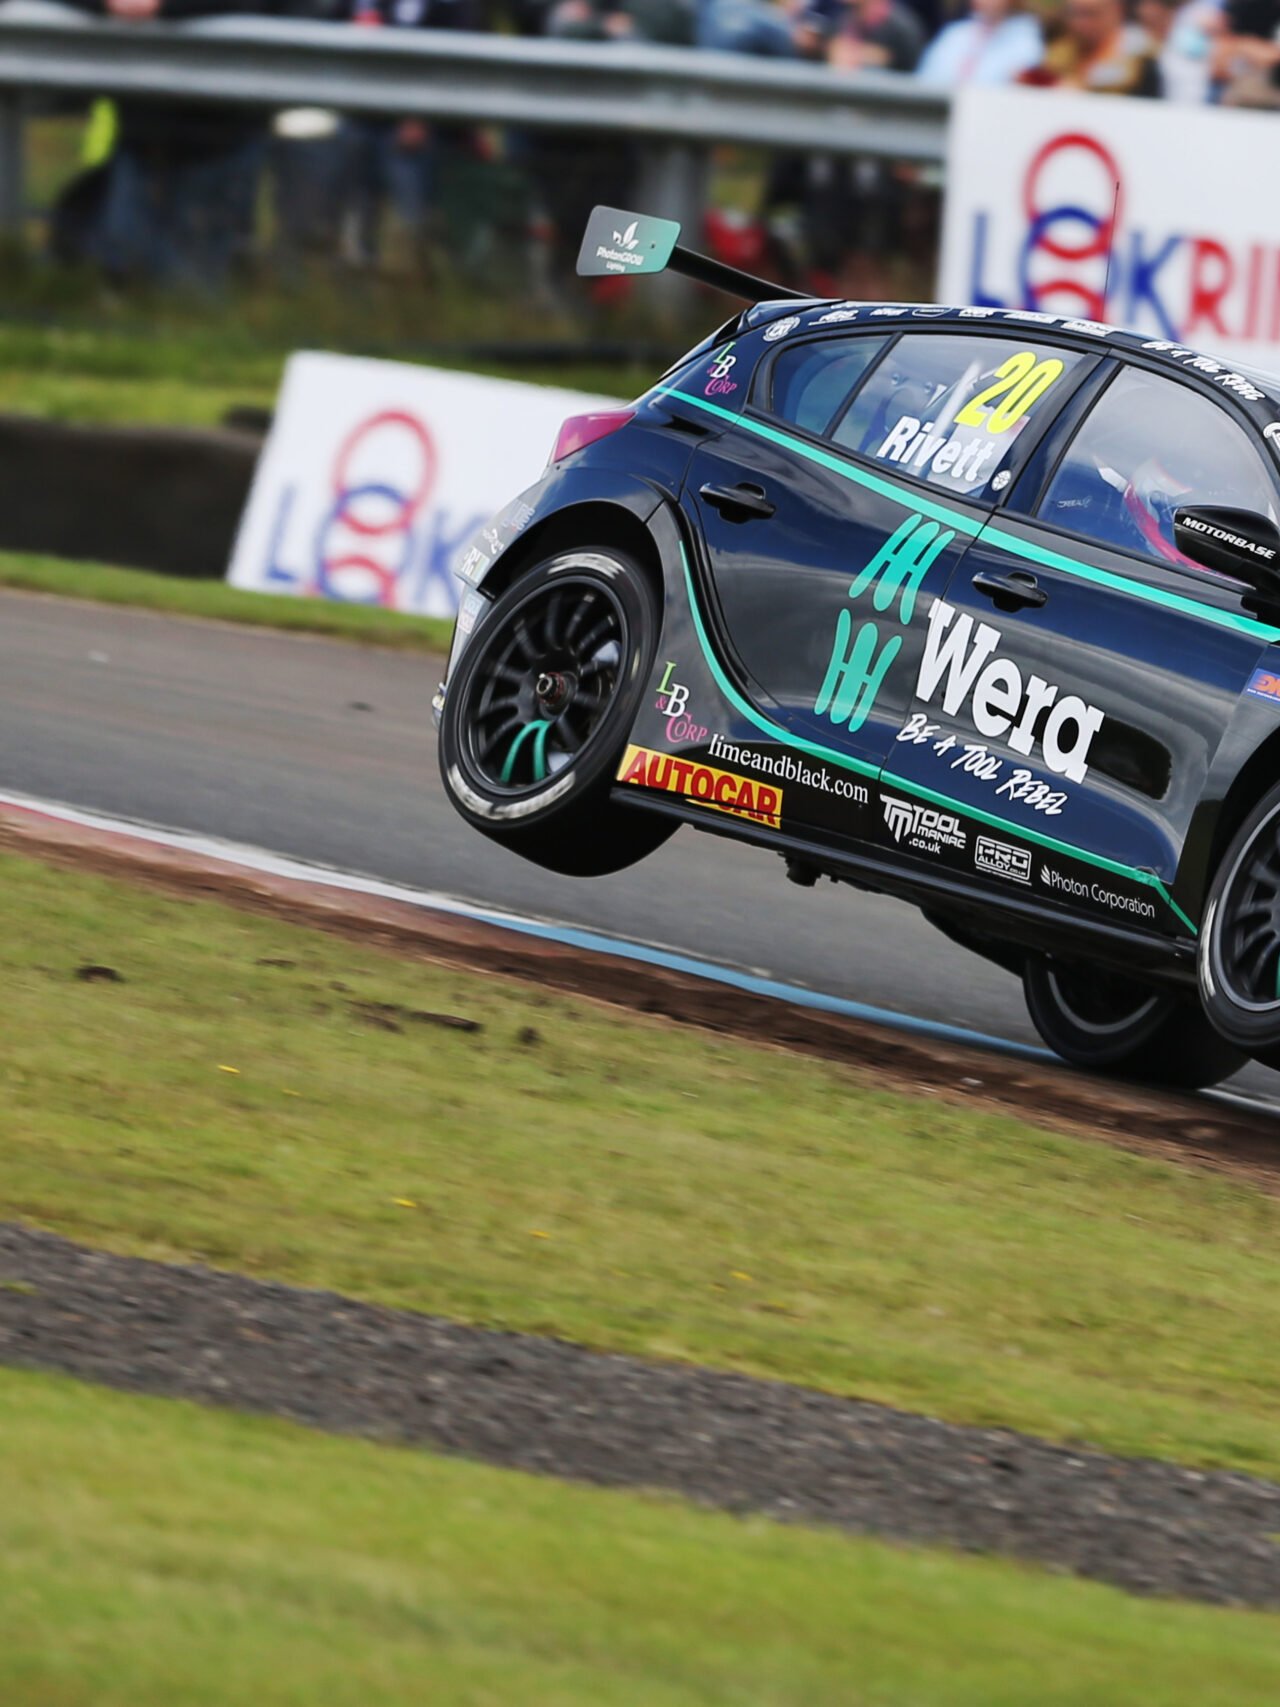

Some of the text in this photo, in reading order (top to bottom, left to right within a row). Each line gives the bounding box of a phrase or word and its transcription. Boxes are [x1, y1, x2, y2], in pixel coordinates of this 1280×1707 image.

[954, 352, 1064, 434] 20
[876, 416, 995, 482] Rivett
[1182, 517, 1276, 560] MOTORBASE
[916, 598, 1104, 784] Wera
[620, 750, 778, 825] AUTOCAR
[708, 734, 869, 804] limeandblack.com
[897, 713, 1068, 815] BE A TOOL REBEL
[908, 837, 941, 854] .co.uk
[912, 805, 967, 839] TOOL
[978, 840, 1028, 868] PRO
[1051, 870, 1090, 899] Photon
[1091, 883, 1156, 918] Corporation
